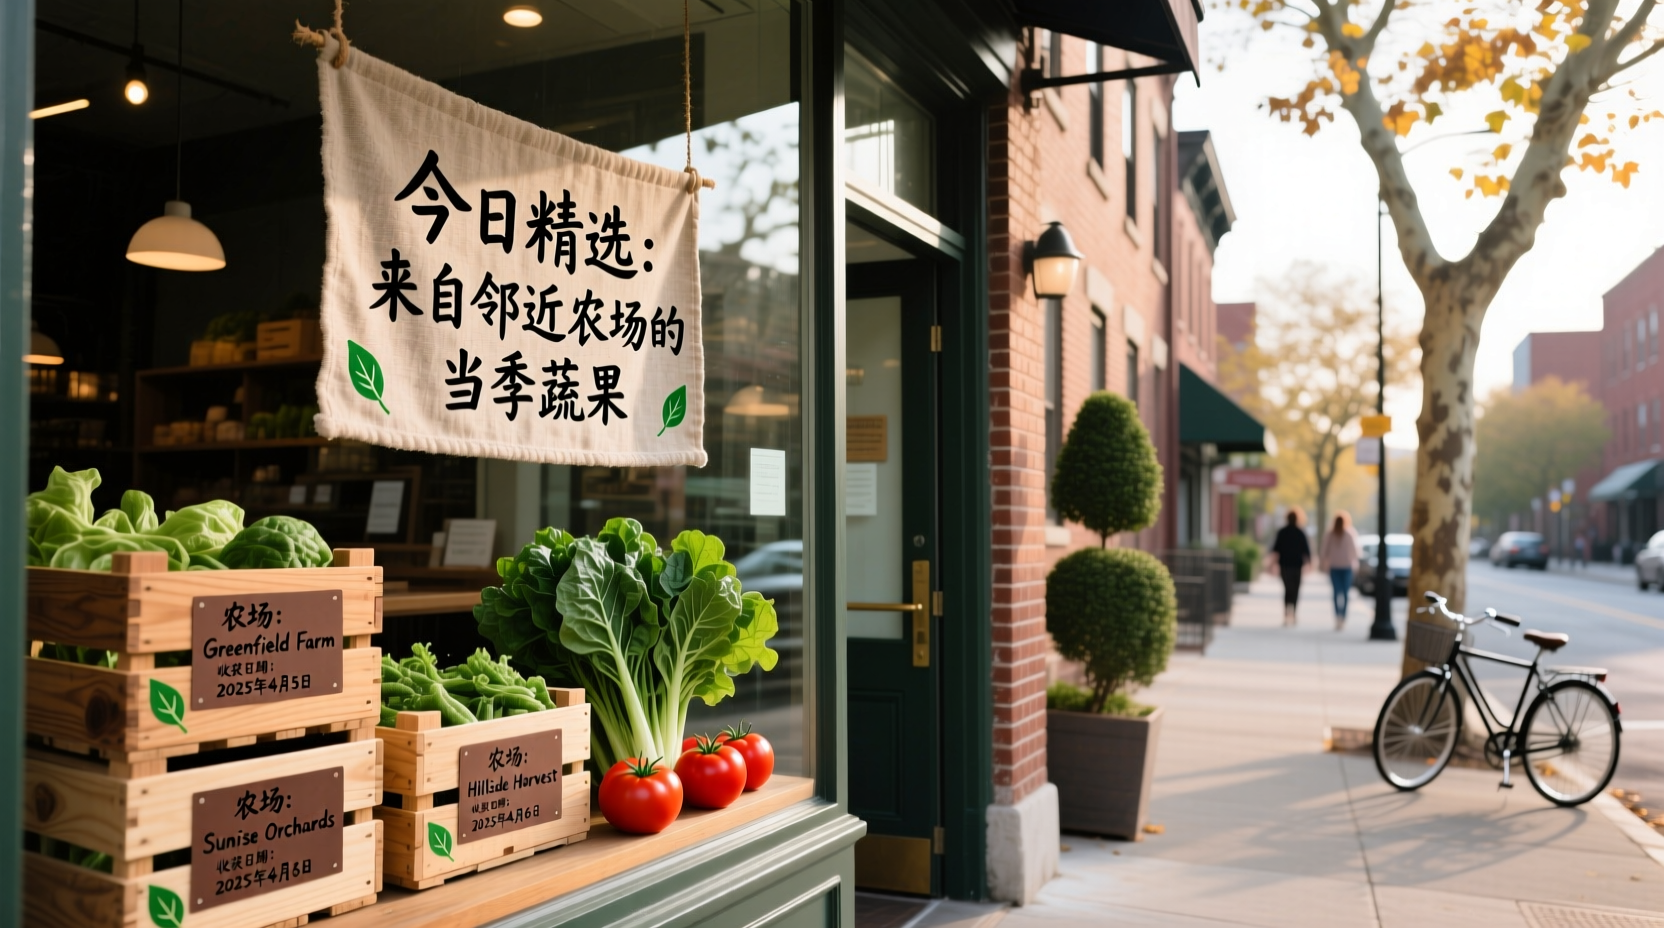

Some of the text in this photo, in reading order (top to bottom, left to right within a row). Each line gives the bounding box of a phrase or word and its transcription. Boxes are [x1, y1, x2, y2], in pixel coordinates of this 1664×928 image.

[394, 149, 654, 280] 今日精选：
[369, 248, 685, 355] 来自邻近农场的
[444, 348, 628, 426] 当季蔬果
[221, 601, 282, 632] 农场：
[203, 630, 335, 659] Greenfield Farm
[216, 674, 311, 698] 2025年4月5日
[488, 746, 528, 772] 农场：
[234, 786, 292, 821] 农场：
[203, 809, 335, 854] Sunise Orchards
[215, 859, 312, 896] 2025年4月6日
